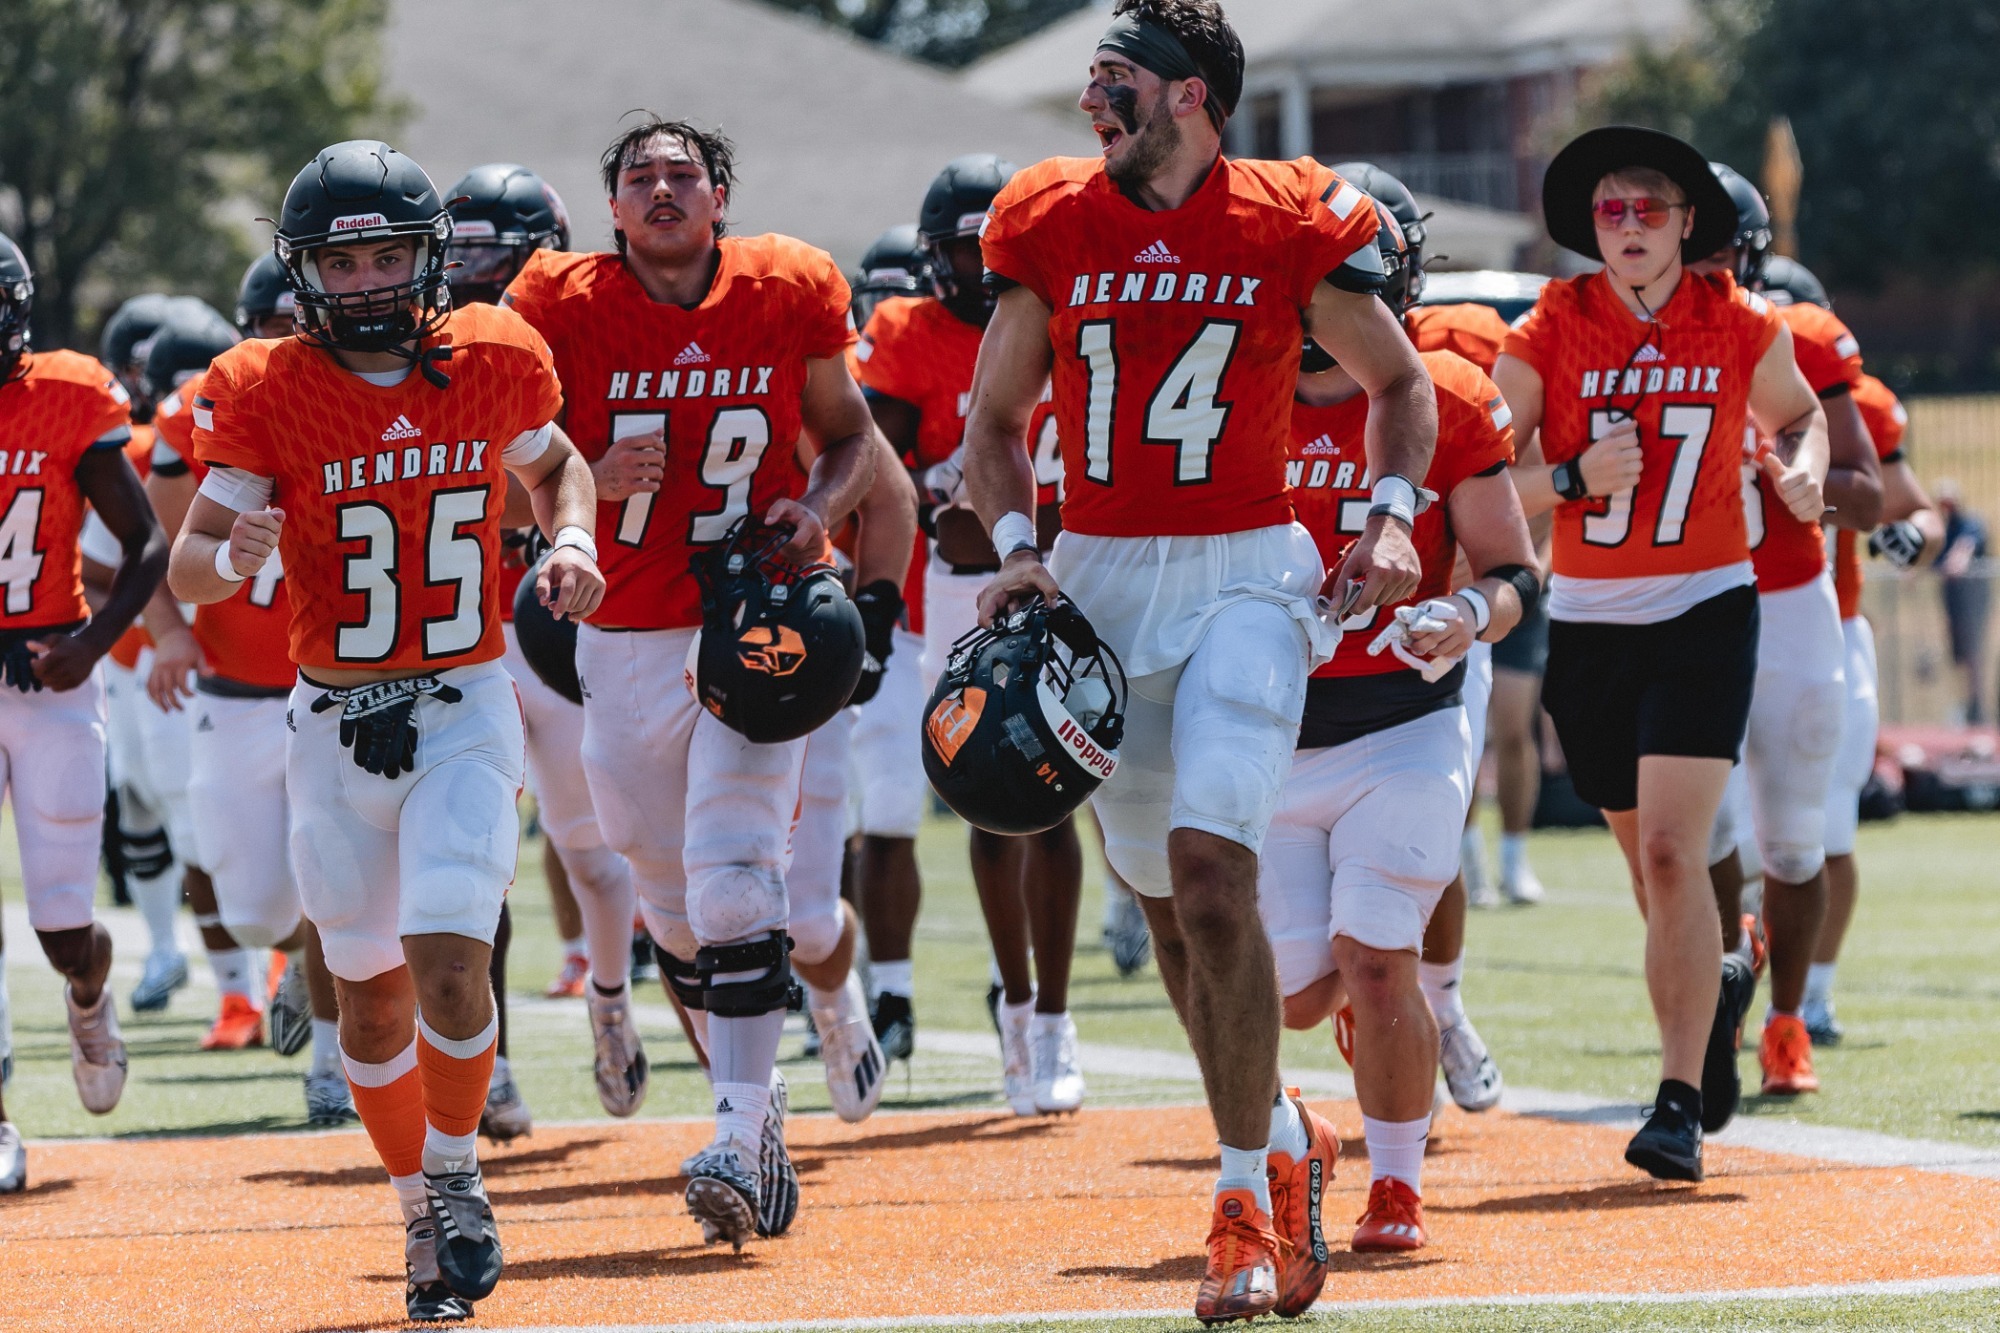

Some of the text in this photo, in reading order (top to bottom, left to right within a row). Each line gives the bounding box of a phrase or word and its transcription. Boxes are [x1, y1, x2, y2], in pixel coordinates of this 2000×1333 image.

[335, 215, 382, 231] Riddell
[1134, 253, 1181, 264] adidas
[1068, 271, 1263, 308] HENDRIX
[673, 354, 711, 366] adidas
[606, 366, 775, 400] HENDRIX
[1580, 366, 1722, 399] HENDRIX
[1076, 316, 1244, 487] 14
[381, 427, 422, 442] adidas
[1302, 446, 1341, 455] adidas
[322, 440, 490, 495] HENDRIX
[608, 403, 773, 549] 79
[0, 486, 46, 617] 4
[334, 482, 492, 664] 35
[346, 677, 434, 714] BATTLE
[1057, 718, 1116, 778] Riddell
[1036, 761, 1059, 785] 14
